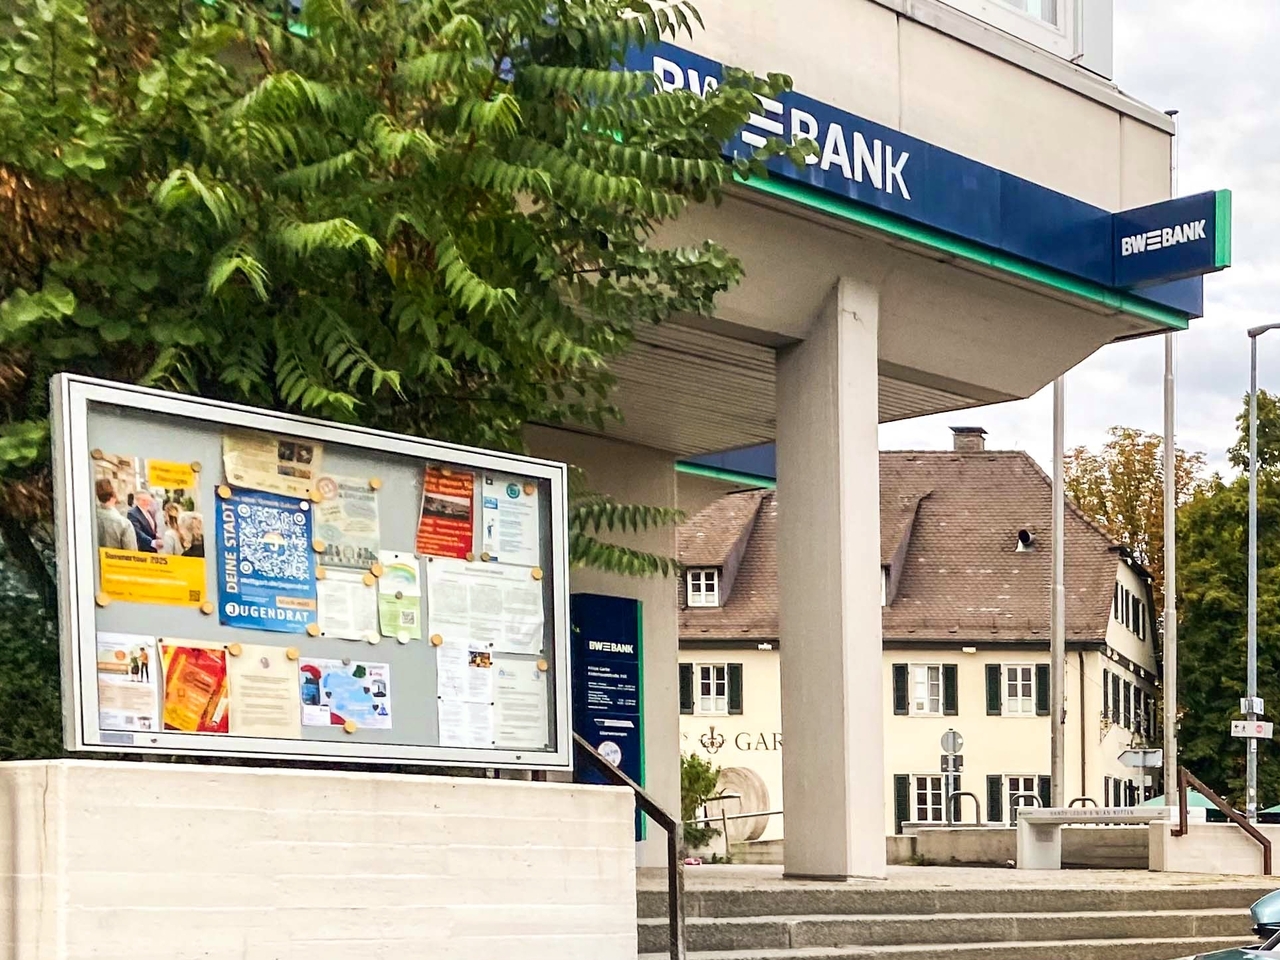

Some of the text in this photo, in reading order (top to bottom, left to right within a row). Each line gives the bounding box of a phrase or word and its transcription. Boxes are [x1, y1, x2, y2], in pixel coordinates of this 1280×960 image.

[790, 107, 911, 201] BANK
[150, 556, 168, 565] 2025
[222, 502, 238, 593] DEINE STADT
[225, 602, 309, 622] JUGENDRAT
